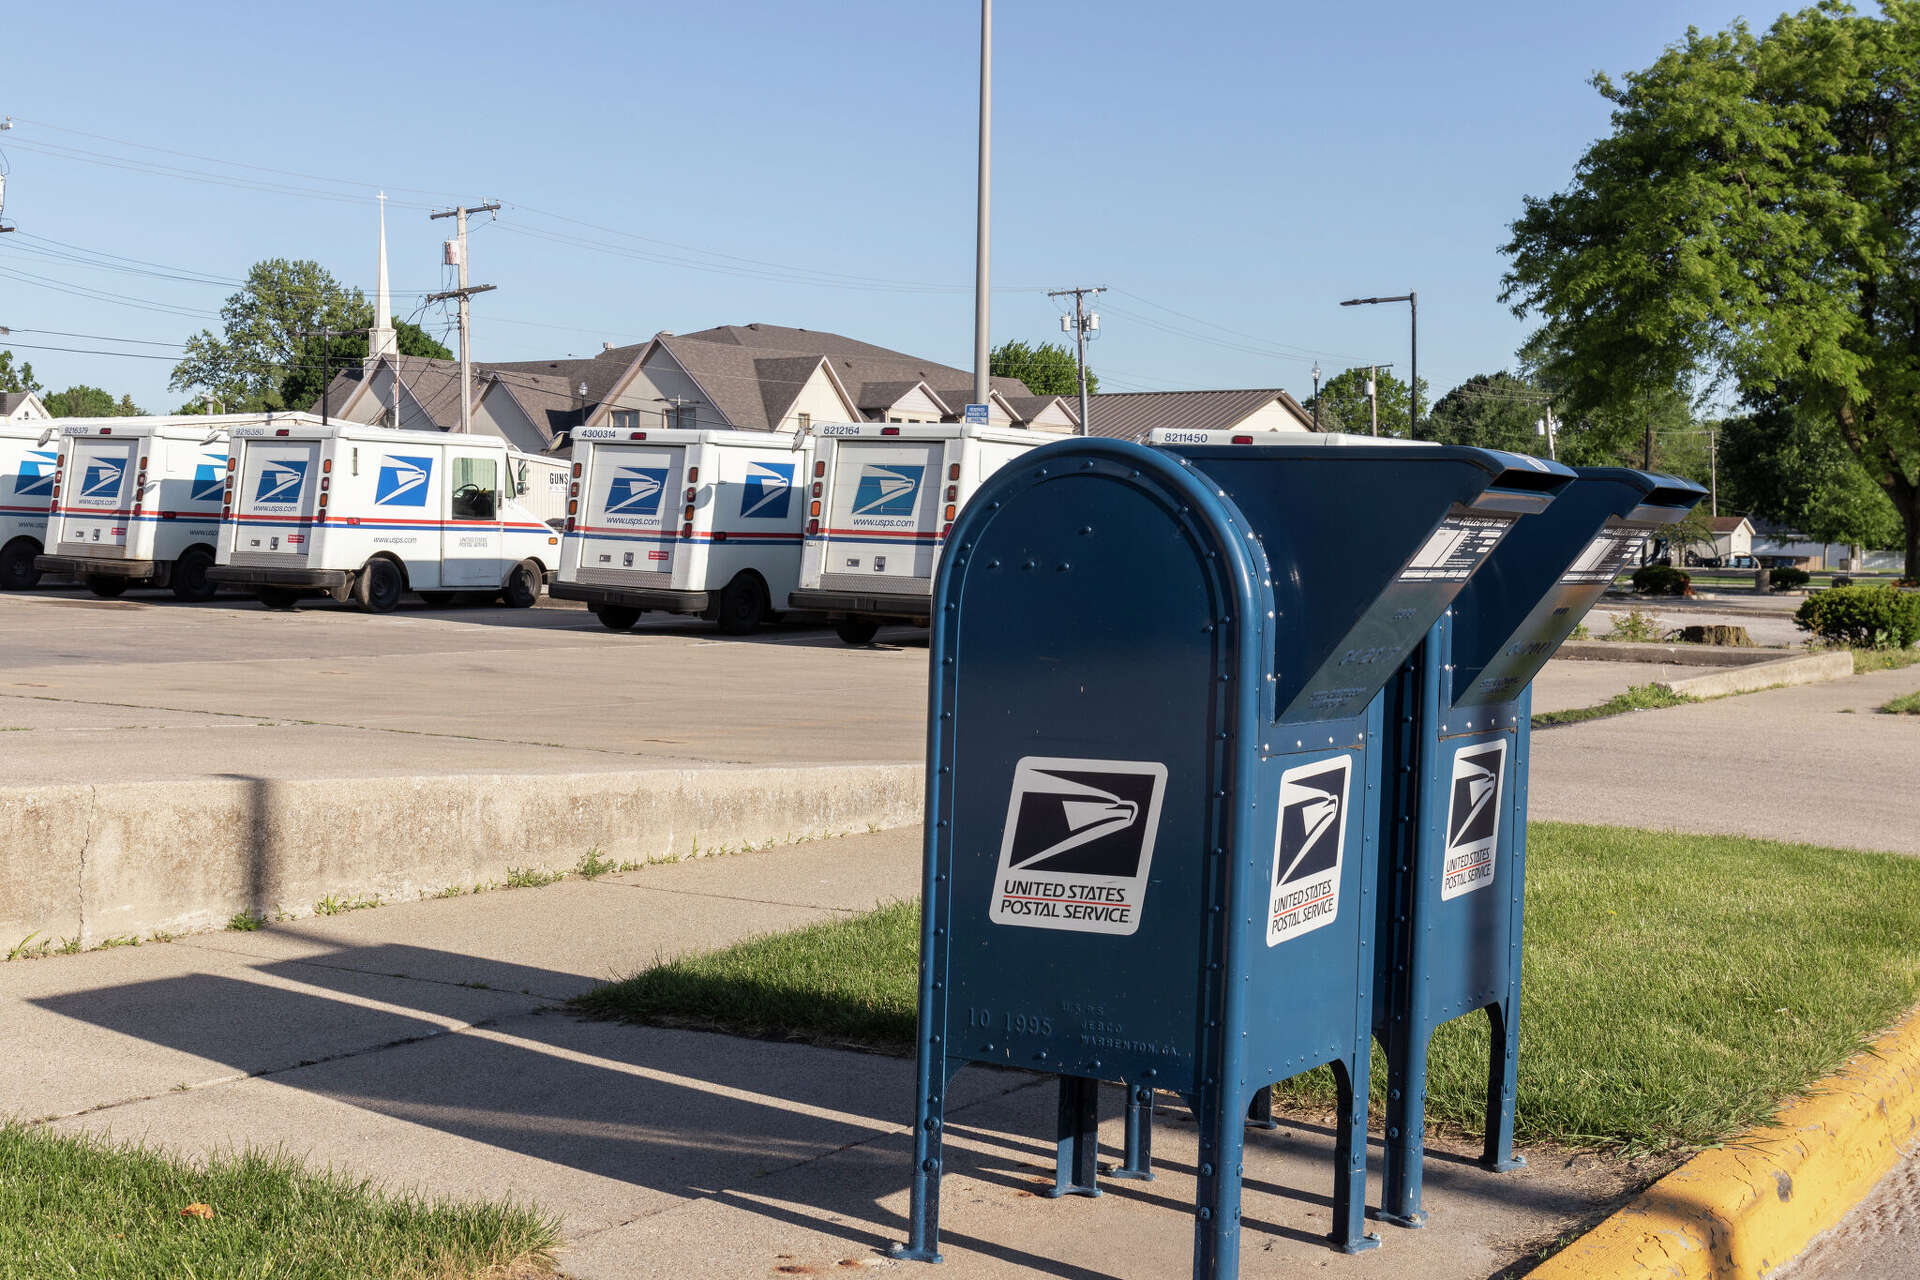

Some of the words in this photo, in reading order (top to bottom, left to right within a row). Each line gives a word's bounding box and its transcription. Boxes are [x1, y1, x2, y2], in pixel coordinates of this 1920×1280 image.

[581, 429, 616, 438] 4300314
[823, 425, 861, 435] 8212164
[1164, 432, 1208, 443] 8211450
[549, 472, 569, 485] GUNS
[78, 498, 117, 506] www.usps.com
[253, 504, 297, 513] www.usps.com
[606, 516, 660, 527] www.usps.com
[852, 517, 915, 529] www.usps.com
[373, 536, 417, 545] www.usps.com
[1446, 852, 1469, 873] UNITED
[1469, 847, 1490, 865] STATES
[1444, 872, 1467, 890] POSTAL
[1467, 863, 1491, 883] SERVICE
[1004, 879, 1065, 898] UNITED
[1067, 884, 1126, 903] STATES
[1273, 888, 1304, 914] UNITED
[1304, 879, 1332, 903] STATES
[1001, 899, 1059, 918] POSTAL
[1063, 904, 1131, 924] SERVICE
[1271, 912, 1302, 935] POSTAL
[1302, 897, 1334, 923] SERVICE
[968, 1006, 991, 1028] 10
[1003, 1012, 1054, 1036] 1995
